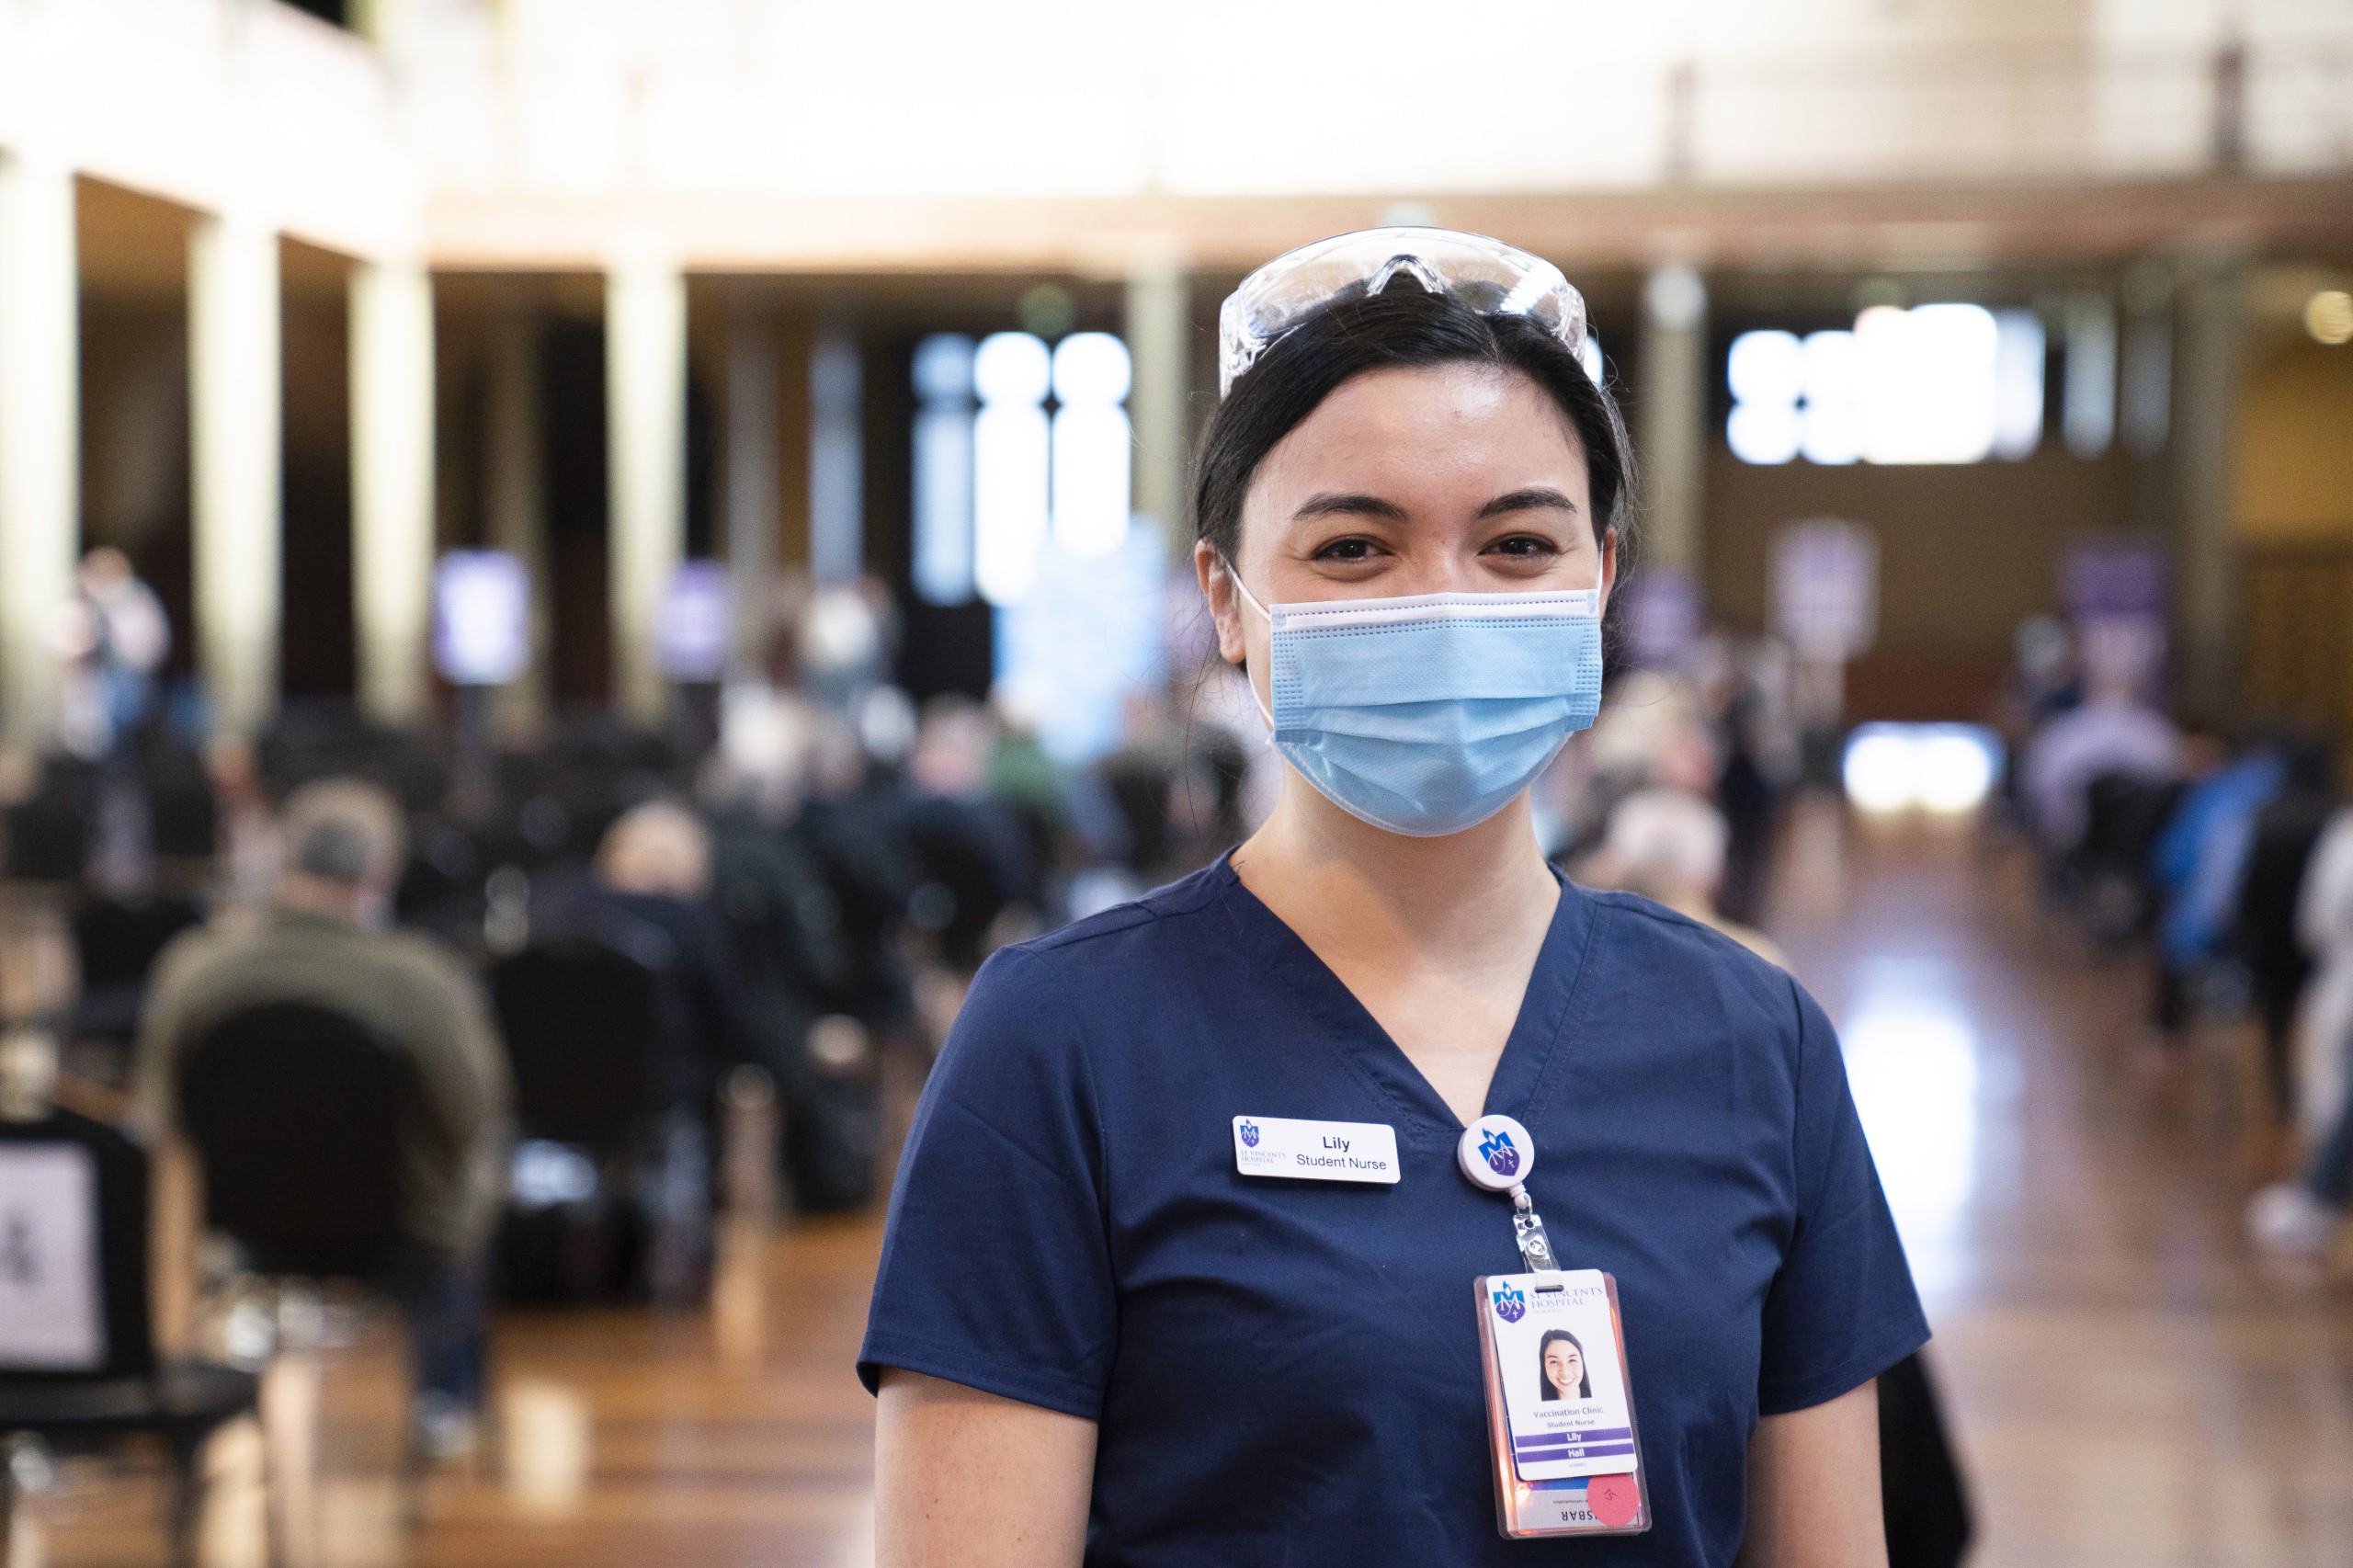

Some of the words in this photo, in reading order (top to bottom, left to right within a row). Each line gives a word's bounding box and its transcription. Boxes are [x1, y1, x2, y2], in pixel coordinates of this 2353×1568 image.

[1323, 1136, 1350, 1153] Lily
[1296, 1153, 1346, 1168] Student
[1349, 1157, 1387, 1170] Nurse
[1531, 1298, 1584, 1309] HOSPITAL
[1533, 1408, 1580, 1418] Vaccination
[1582, 1406, 1604, 1415] Clinic
[1547, 1420, 1574, 1428] Student
[1566, 1432, 1582, 1443] Lily
[1567, 1448, 1585, 1458] Hall
